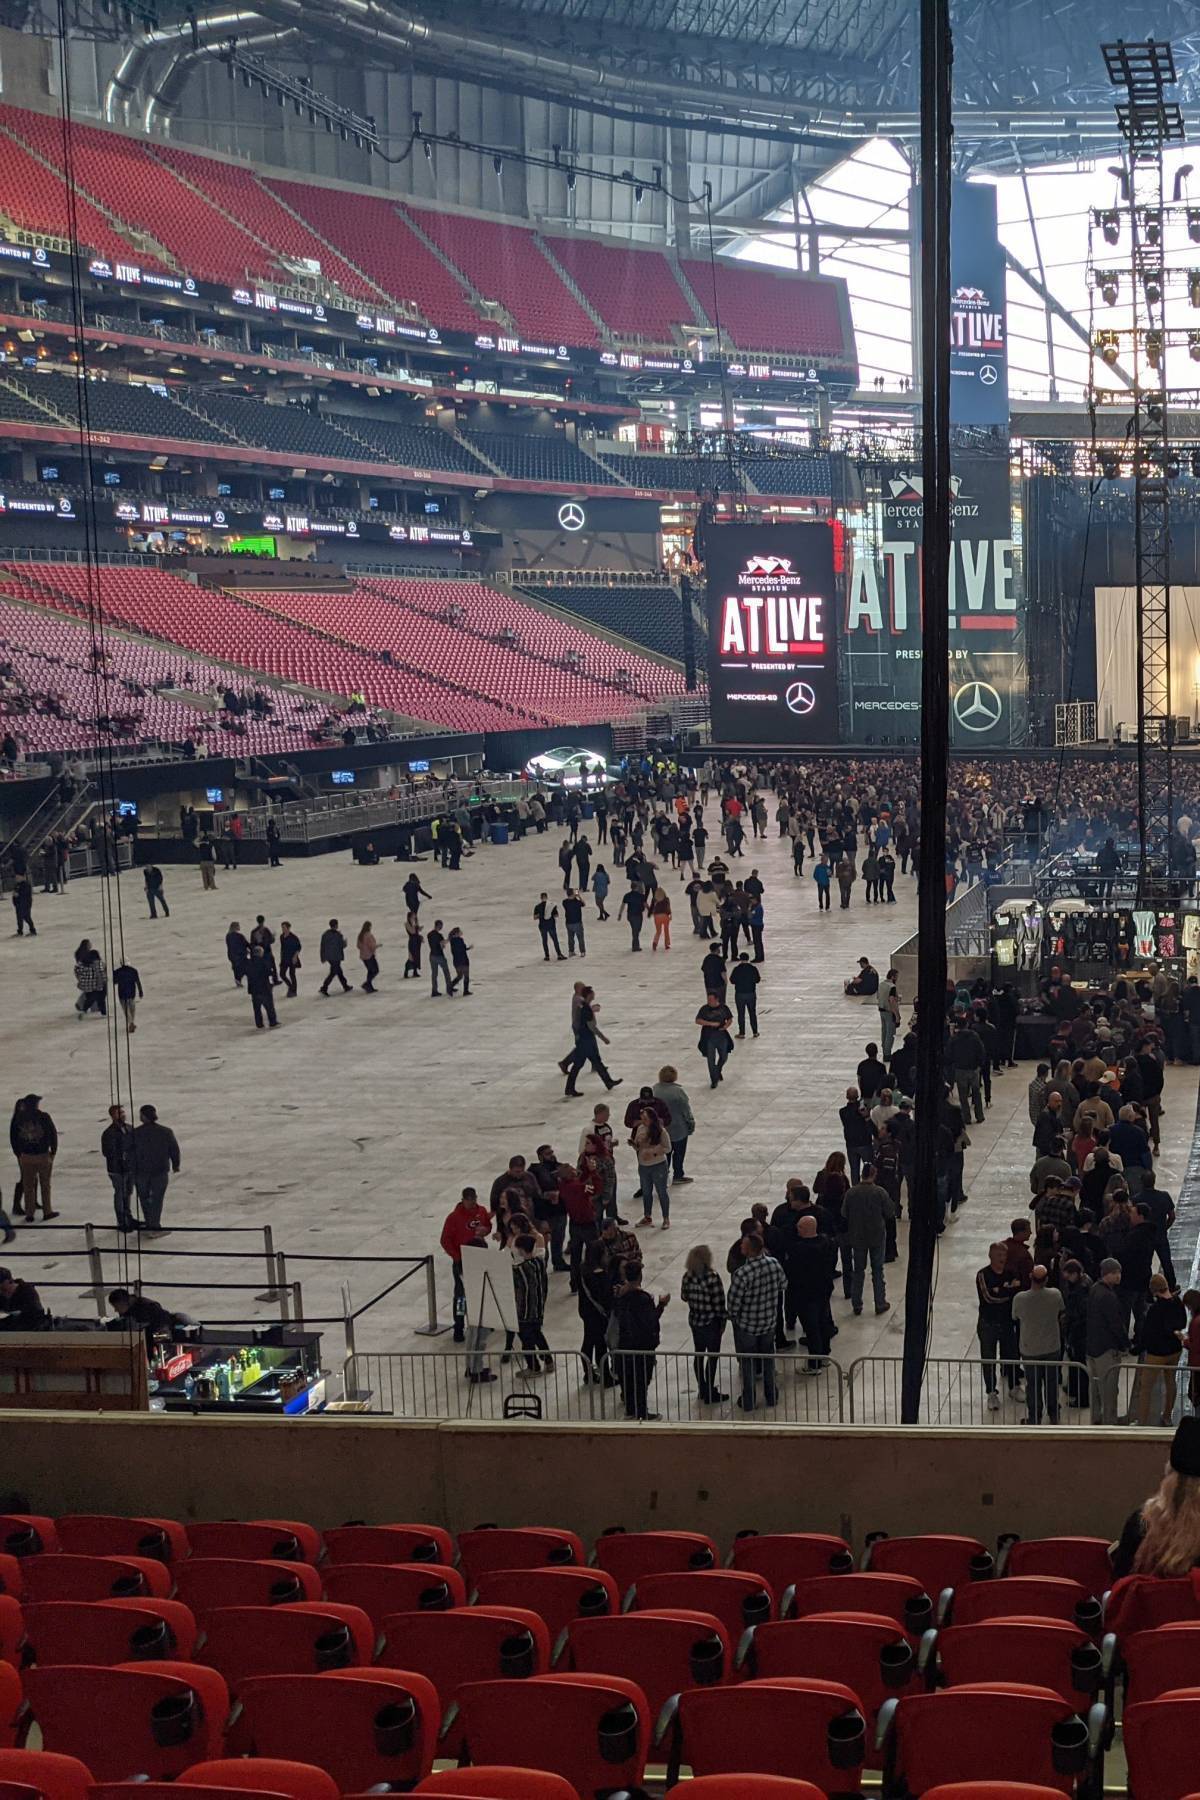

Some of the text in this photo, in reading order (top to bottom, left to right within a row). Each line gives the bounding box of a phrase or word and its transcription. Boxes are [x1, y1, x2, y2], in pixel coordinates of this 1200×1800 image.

[738, 574, 801, 585] Mercedes-Benz
[723, 597, 824, 652] ATLIVE
[955, 650, 969, 659] BY
[854, 701, 923, 711] MERCEDES-
